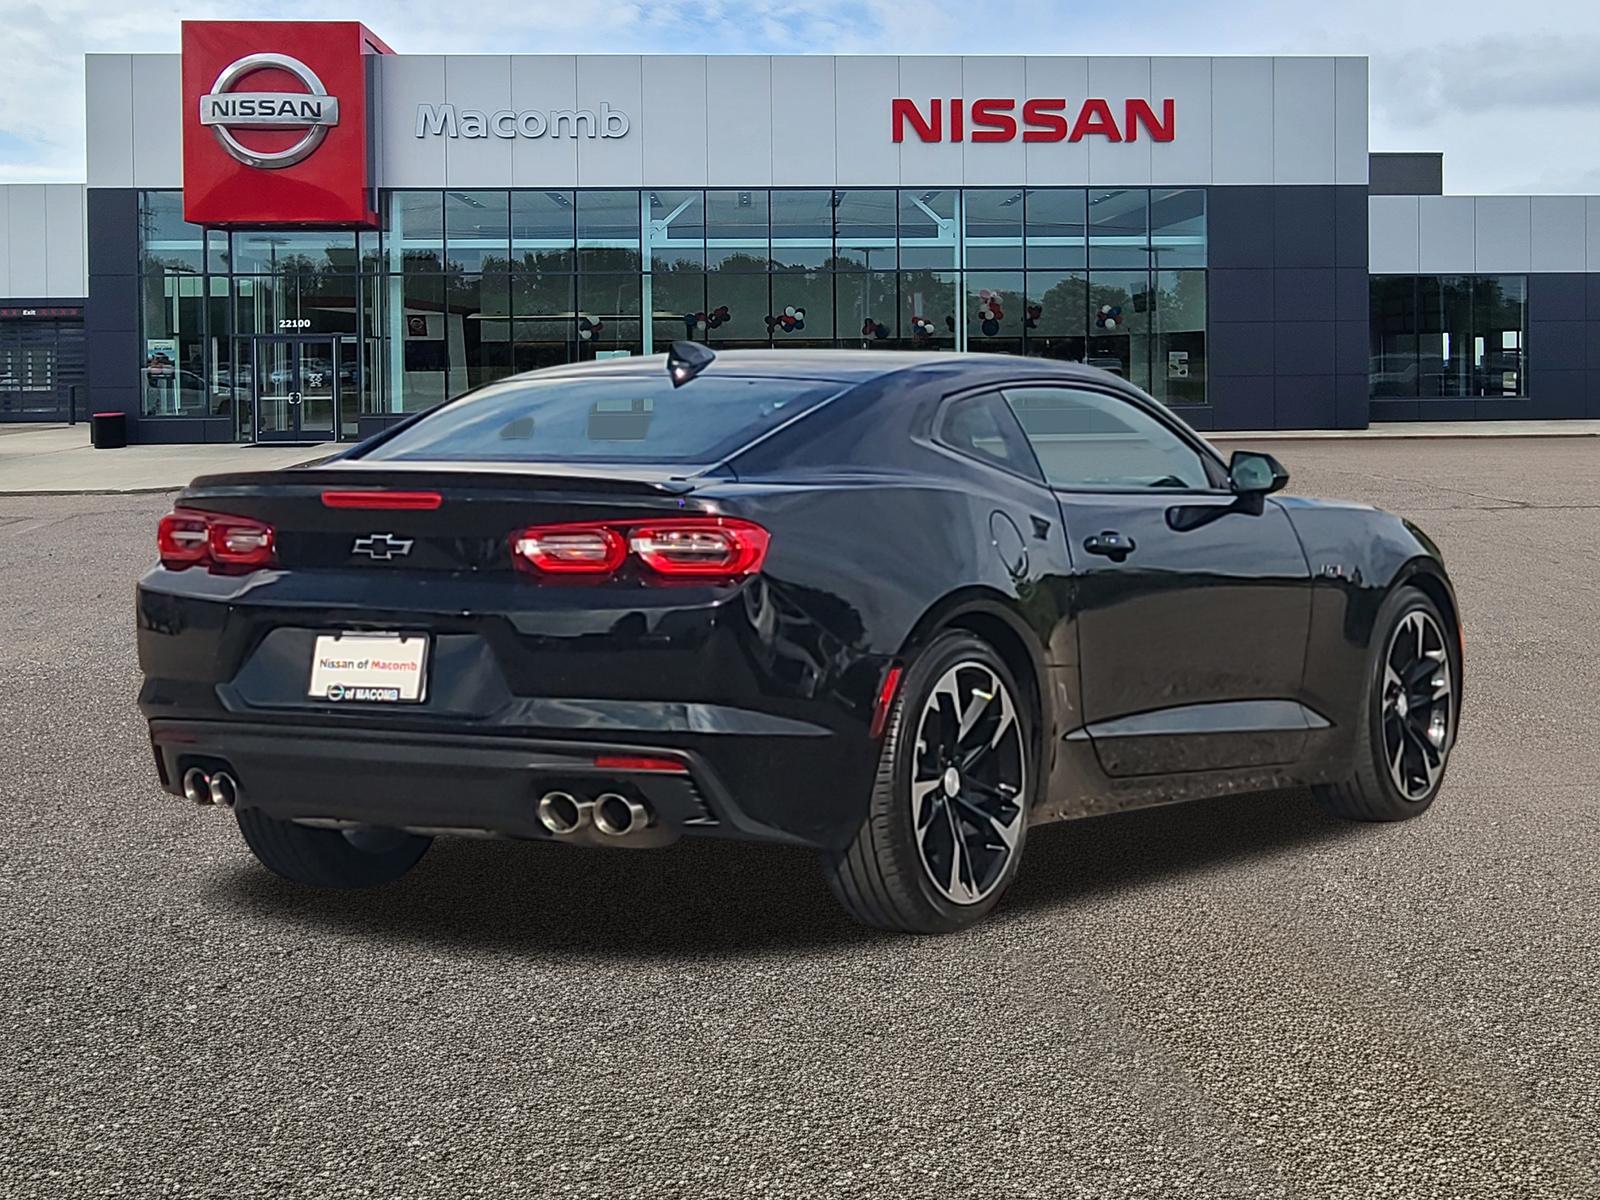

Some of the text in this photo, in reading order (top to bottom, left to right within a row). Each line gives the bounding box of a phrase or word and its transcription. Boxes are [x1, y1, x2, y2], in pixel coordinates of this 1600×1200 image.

[211, 100, 322, 118] NISSAN
[415, 102, 630, 138] Macomb
[892, 98, 1176, 143] NISSAN
[279, 319, 311, 328] 22100
[319, 659, 417, 672] Nissan of Macomb
[344, 688, 355, 699] of
